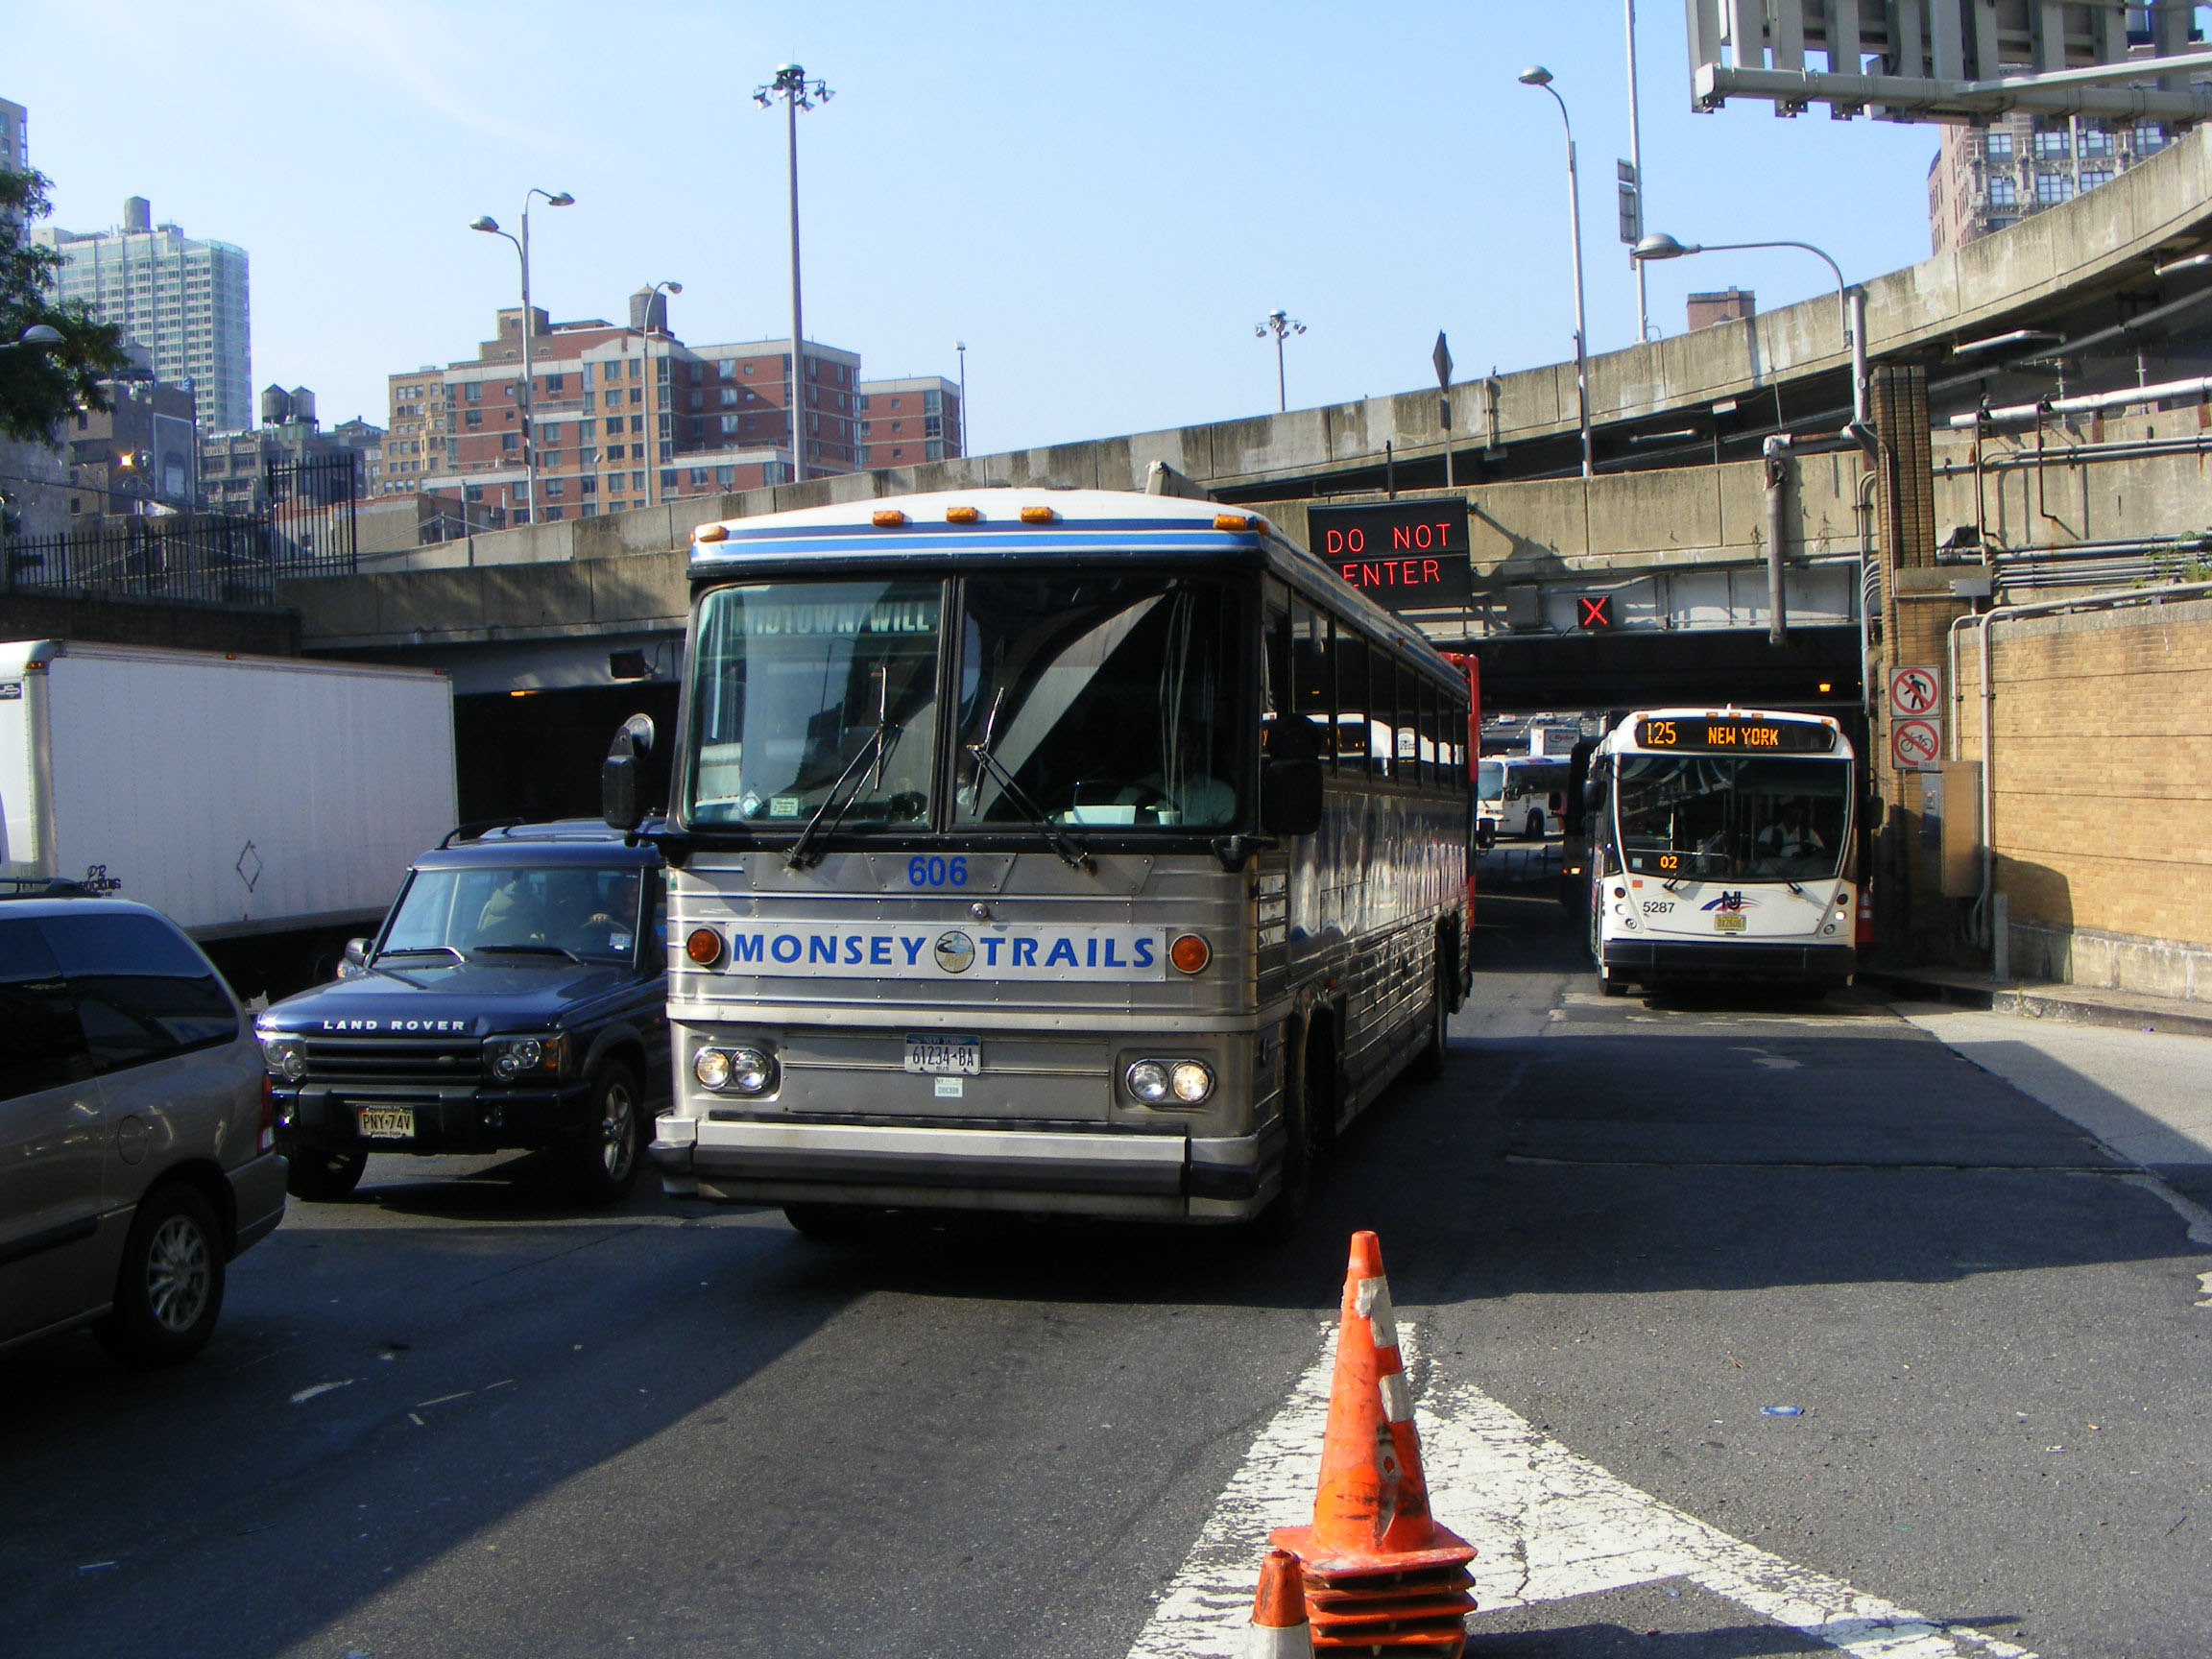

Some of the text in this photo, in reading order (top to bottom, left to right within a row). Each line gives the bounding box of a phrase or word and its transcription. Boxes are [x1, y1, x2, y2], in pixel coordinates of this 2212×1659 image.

[1327, 523, 1451, 554] DO NOT
[1342, 560, 1440, 588] ENTER
[1647, 722, 1779, 746] 125 NEW YORK
[908, 855, 968, 886] 606
[1660, 855, 1678, 869] 02
[1643, 902, 1674, 913] 5287
[1721, 891, 1742, 910] NJ
[733, 934, 926, 966] MONSEY
[979, 937, 1154, 968] TRAILS
[323, 1020, 464, 1030] LAND ROVER
